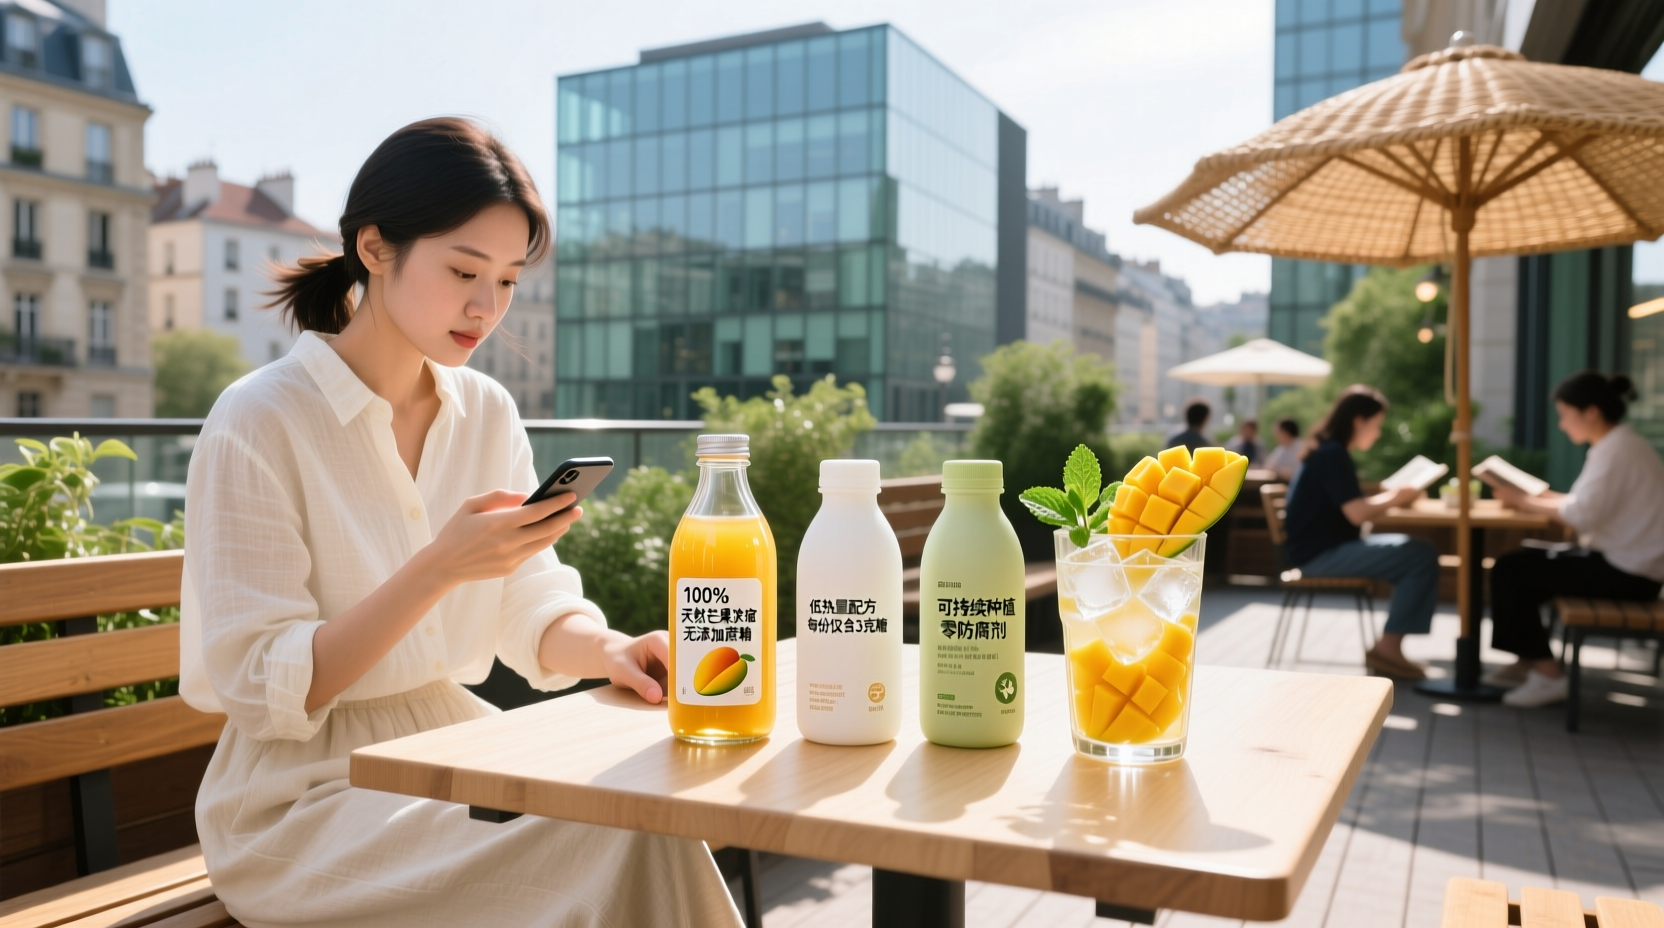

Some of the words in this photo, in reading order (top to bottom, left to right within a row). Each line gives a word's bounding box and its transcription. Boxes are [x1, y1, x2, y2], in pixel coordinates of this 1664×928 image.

[684, 587, 729, 604] 100%
[937, 597, 1016, 617] 可持续种植
[940, 620, 1007, 640] 零防腐剂
